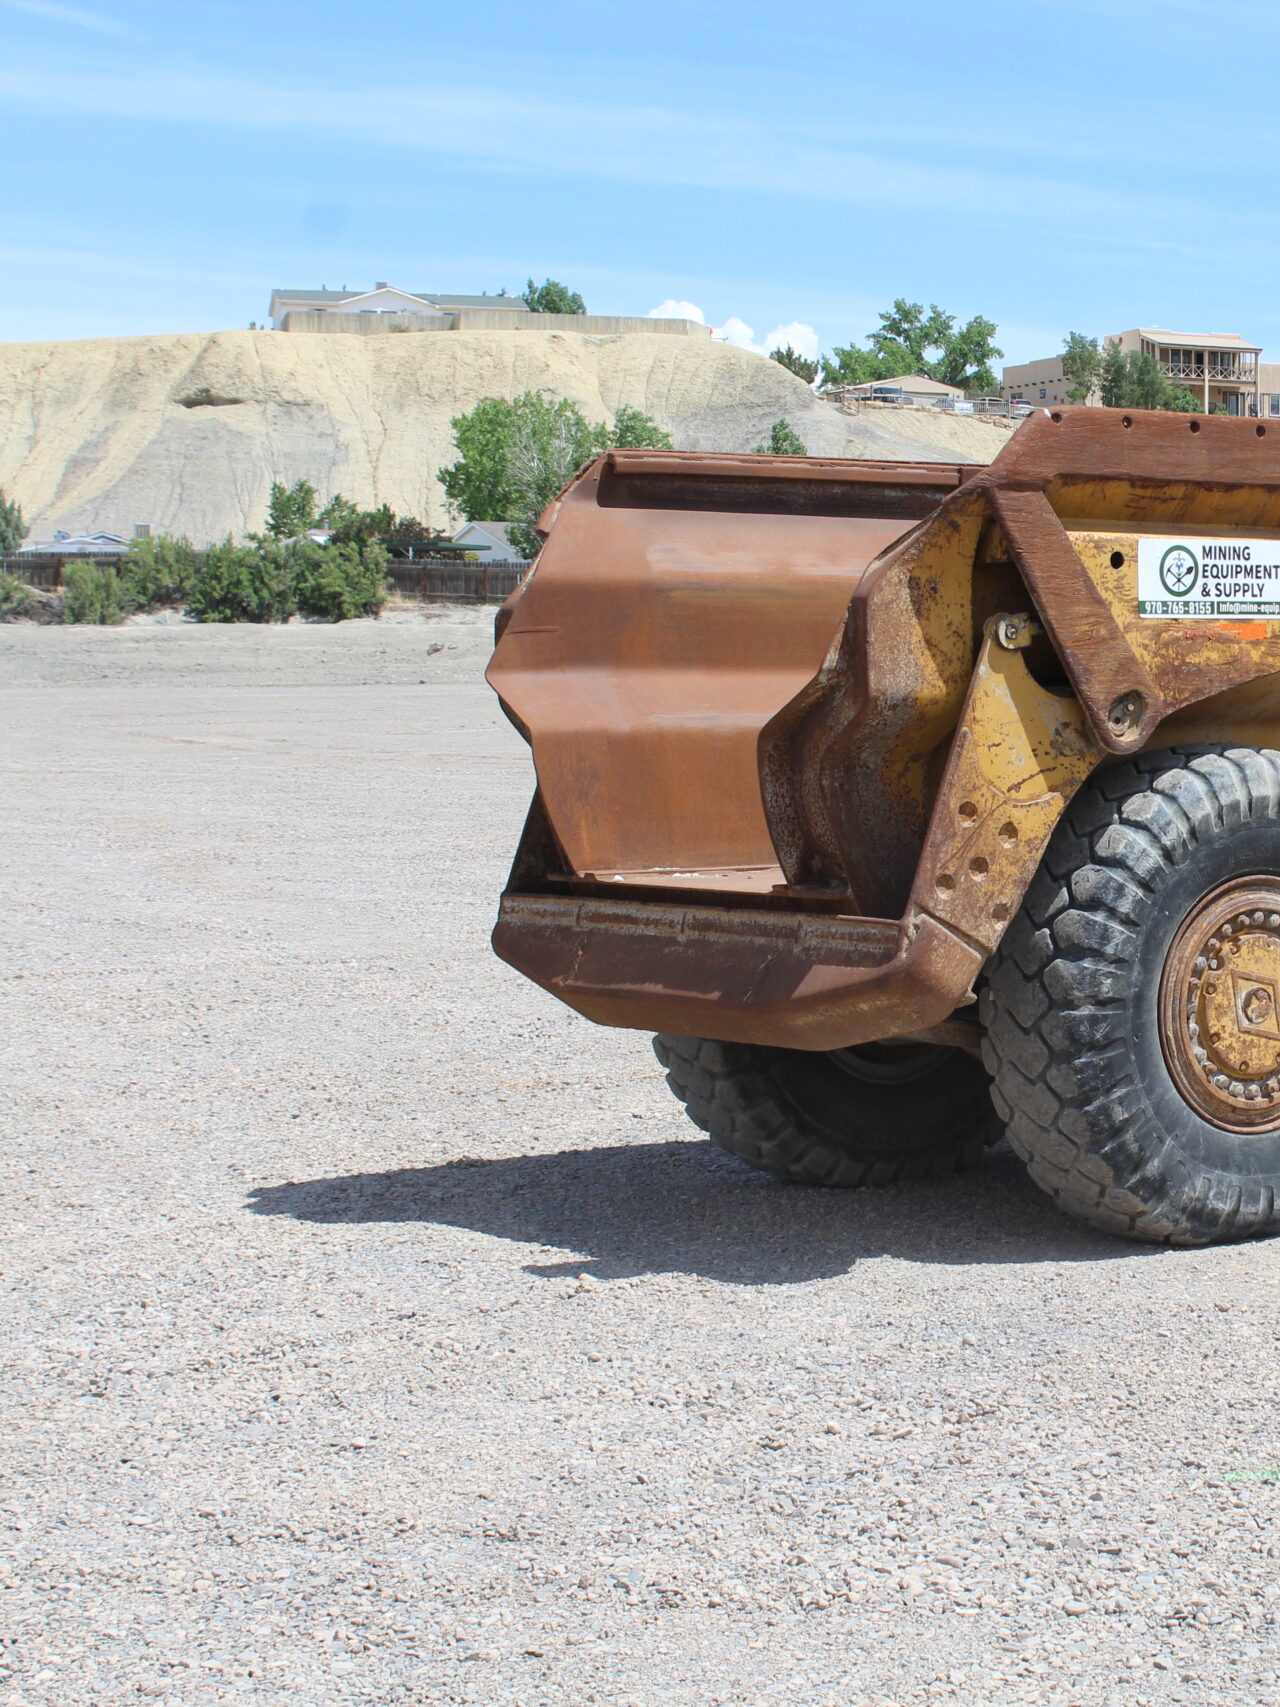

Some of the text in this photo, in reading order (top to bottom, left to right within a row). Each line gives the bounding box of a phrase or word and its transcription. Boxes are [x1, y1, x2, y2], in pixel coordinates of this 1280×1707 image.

[1202, 545, 1251, 561] MINING
[1202, 564, 1280, 579] EQUIPMENT
[1201, 582, 1265, 597] & SUPPLY
[1145, 601, 1212, 614] 970-765-8155
